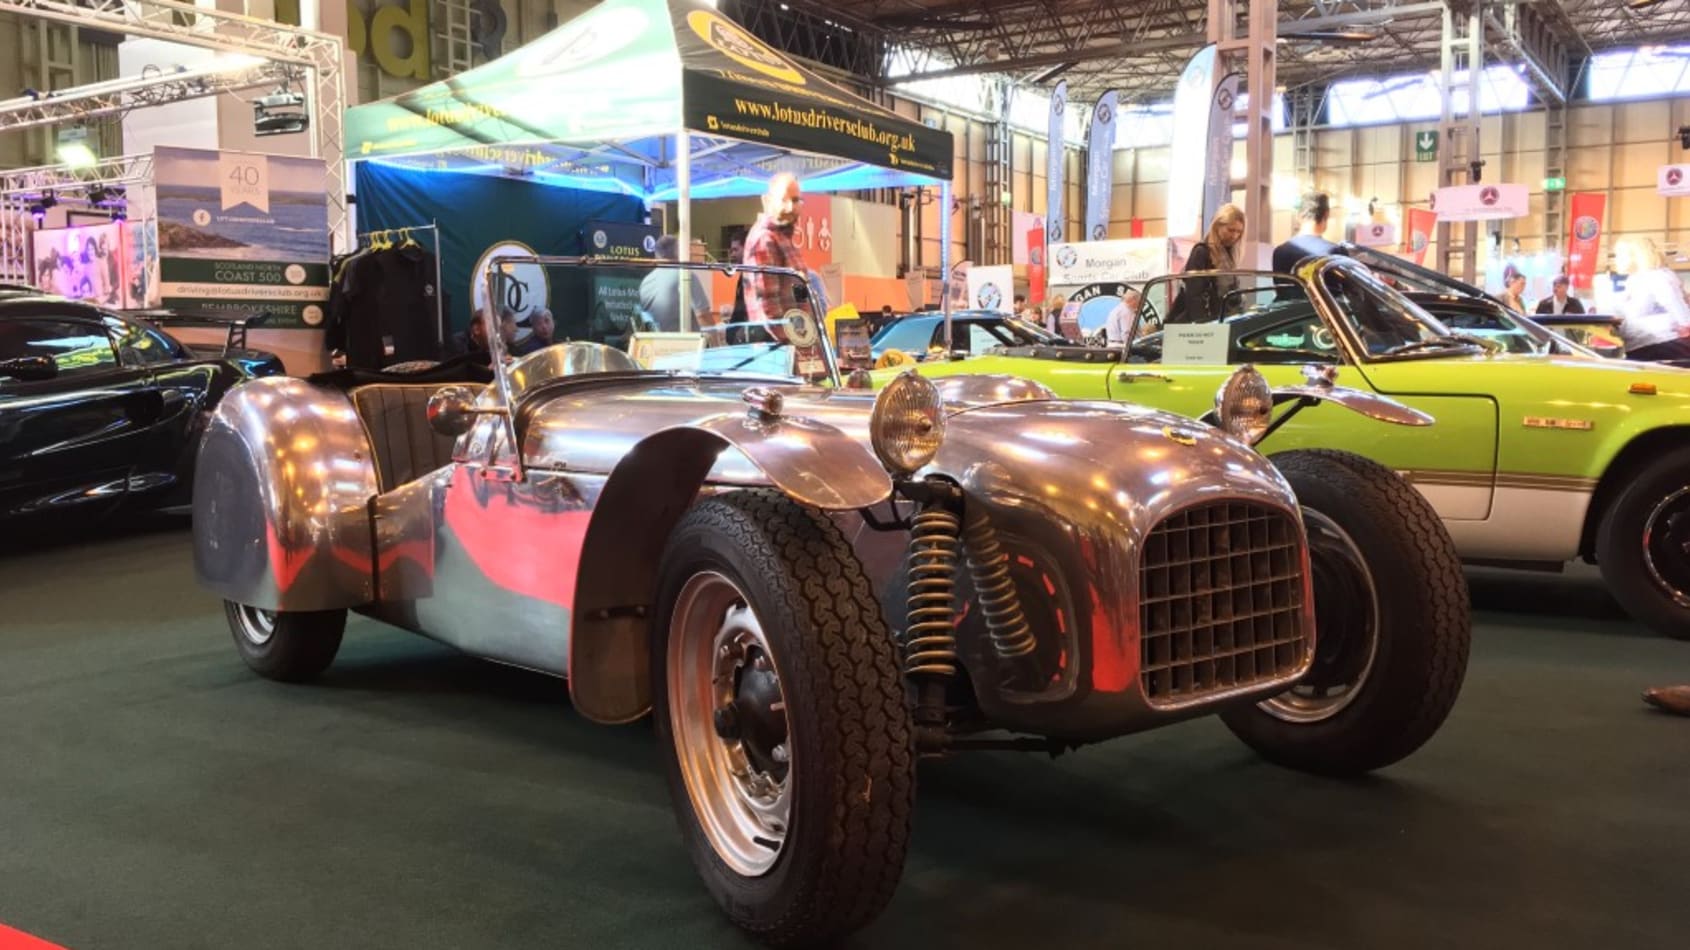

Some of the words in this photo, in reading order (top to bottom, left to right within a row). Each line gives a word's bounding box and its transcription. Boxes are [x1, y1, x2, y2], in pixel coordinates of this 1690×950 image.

[734, 98, 916, 153] www.lotusdriversclub.org.uk
[229, 165, 260, 187] 40
[610, 245, 639, 257] LOTUS
[1085, 257, 1127, 269] Morgan
[215, 270, 256, 282] COAST
[259, 272, 281, 283] 500
